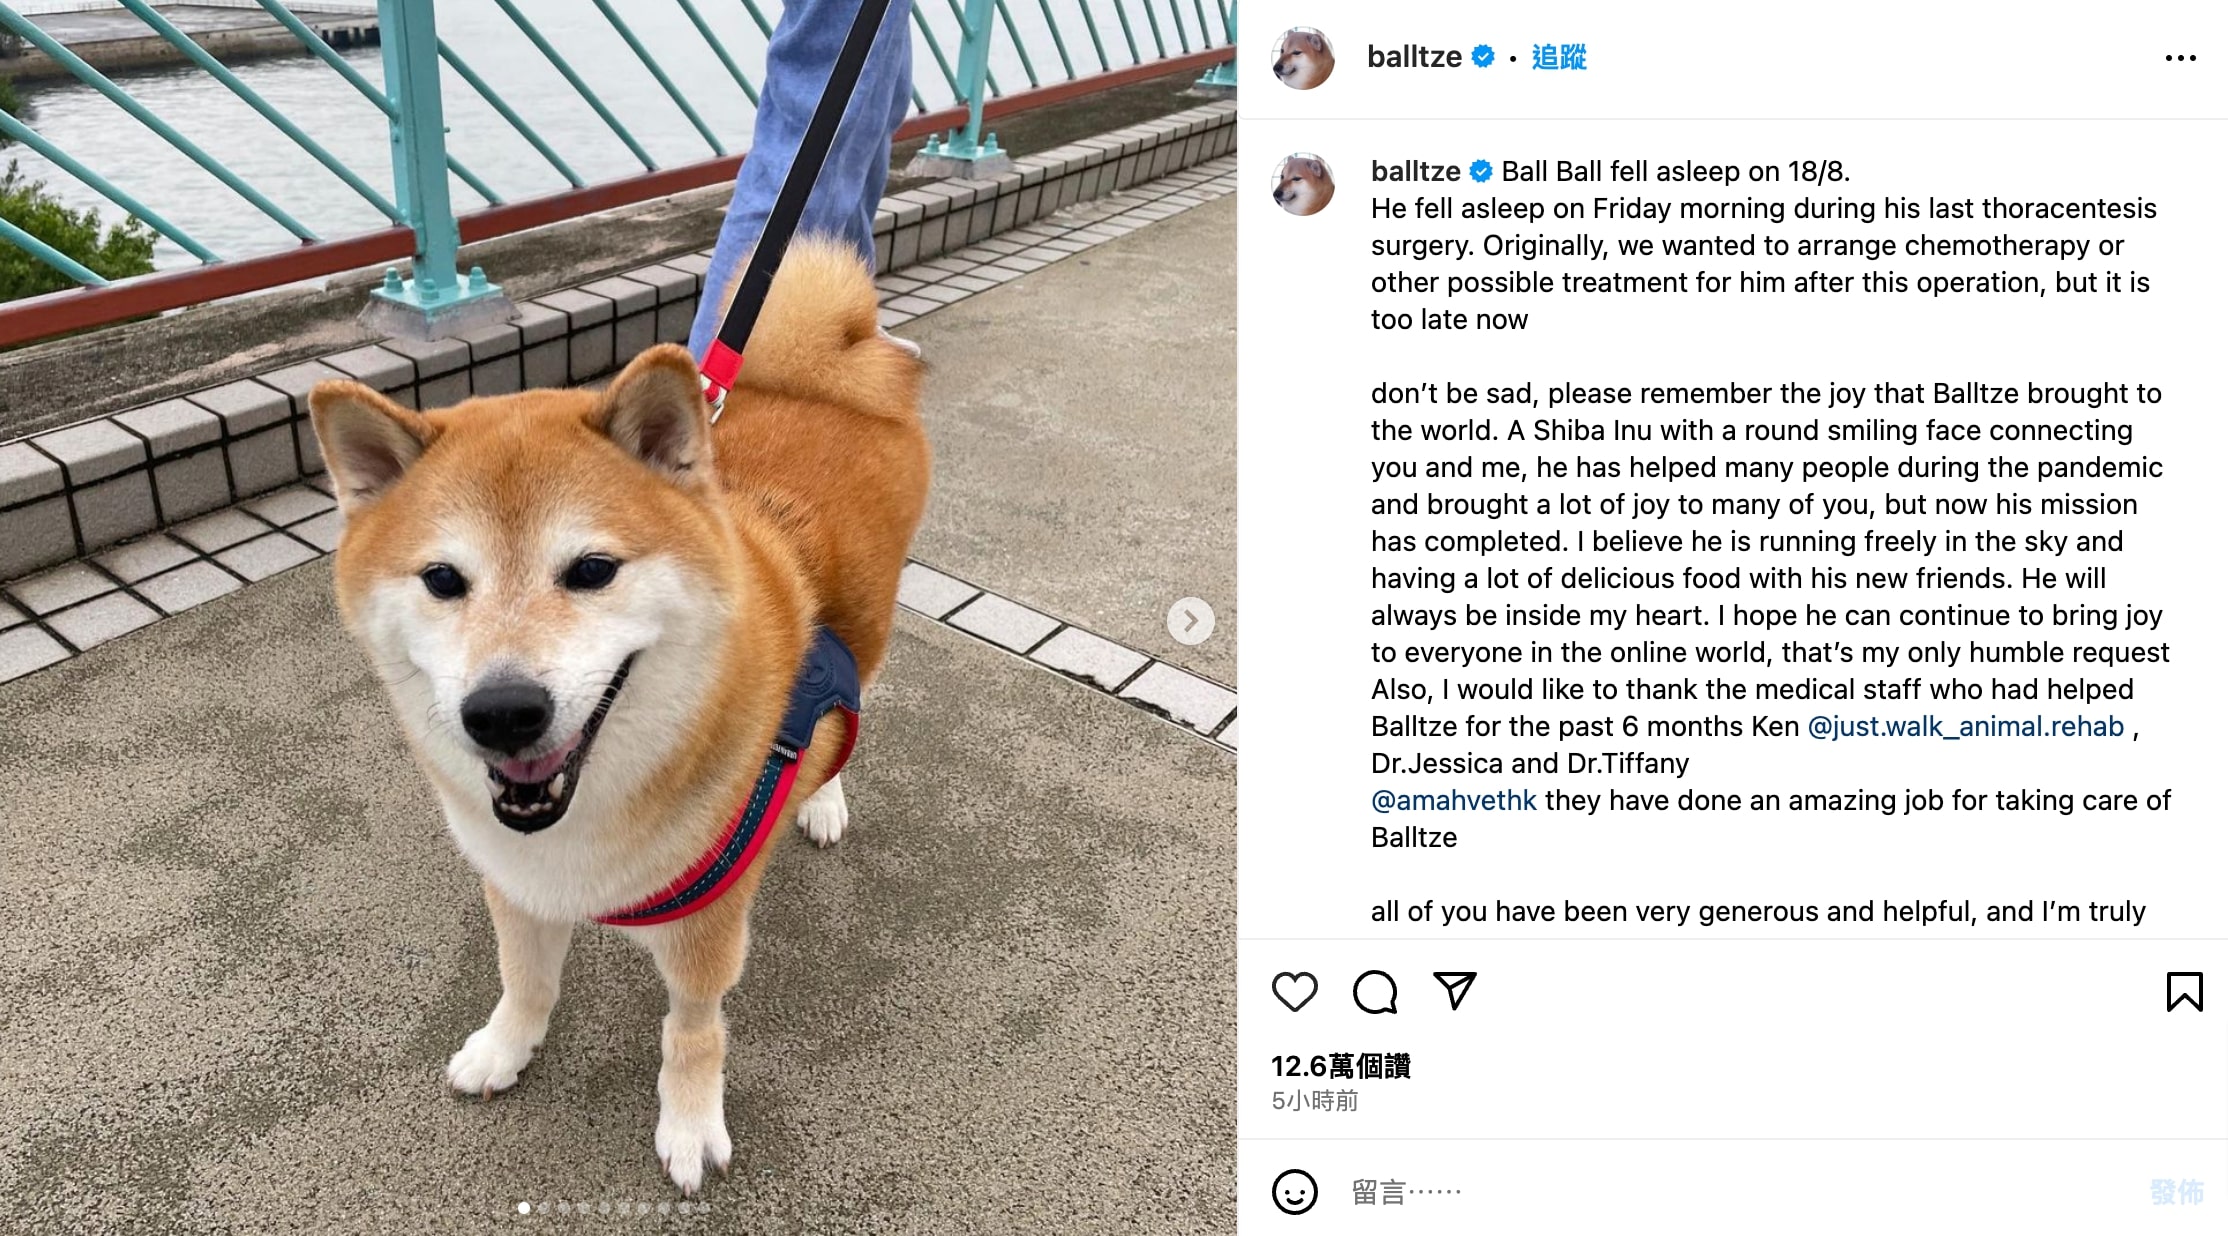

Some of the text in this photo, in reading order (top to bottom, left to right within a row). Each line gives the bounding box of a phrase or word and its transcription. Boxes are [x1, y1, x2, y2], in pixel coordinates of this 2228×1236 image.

[1368, 43, 1463, 68] balltze
[1531, 43, 1588, 71] 追蹤
[1372, 159, 1850, 187] balltze Ball Ball fell asleep 18/8.
[1414, 196, 2157, 224] fell asleep Friday morning during his last thoracentesis
[1371, 233, 2091, 261] surgery. Originally, wanted arrange chemotherapy
[1371, 270, 2122, 298] other possible treatment for him after this operation, but it
[1370, 307, 1529, 330] too late now
[1486, 381, 1539, 409] sad,
[1549, 381, 1632, 409] please
[1641, 381, 1773, 404] remember
[1779, 381, 1822, 404] the
[1827, 381, 1867, 409] joy
[1873, 381, 1925, 404] that
[1934, 381, 2019, 404] Balltze
[2028, 381, 2129, 409] brought
[1370, 418, 2133, 446] the world. Shiba Inu with round smiling face connecting
[1371, 455, 2163, 483] you and me, has helped many people during the pandemic
[1371, 492, 2138, 520] and brought lot joy many you, but now his mission
[1372, 529, 2123, 557] has completed. believe running freely the sky and
[1372, 566, 2106, 594] having lot delicious food with his new friends. will
[1371, 603, 2164, 631] always inside heart. hope can continue bring joy
[1404, 646, 1523, 668] everyone
[1560, 640, 1602, 663] the
[1610, 640, 1687, 663] online
[1694, 640, 1772, 668] world,
[1907, 640, 1962, 668] only
[1970, 640, 2065, 663] humble
[2073, 642, 2170, 668] request
[1371, 677, 2134, 705] Also, would like thank the medical staff who had helped
[1372, 714, 2125, 742] Balltze for the past months Ken @just.walk_animal.rehab
[1372, 751, 1690, 779] Dr.Jessica and Dr.Tiffany
[1371, 788, 2138, 816] @amahvethk they have done amazing job for taking care
[1372, 825, 1458, 848] Balltze
[1371, 899, 1399, 922] all
[1440, 905, 1487, 927] you
[1496, 899, 1556, 922] have
[1564, 899, 1627, 922] been
[1635, 905, 1691, 927] very
[1699, 905, 1819, 927] generous
[1827, 899, 1874, 922] and
[1883, 899, 1977, 927] helpful,
[1986, 899, 2033, 922] and
[2088, 899, 2147, 927] truly
[1271, 1051, 1412, 1080] 12.6萬個讚
[1272, 1088, 1359, 1112] 5小時前
[2149, 1177, 2205, 1206] 發佈
